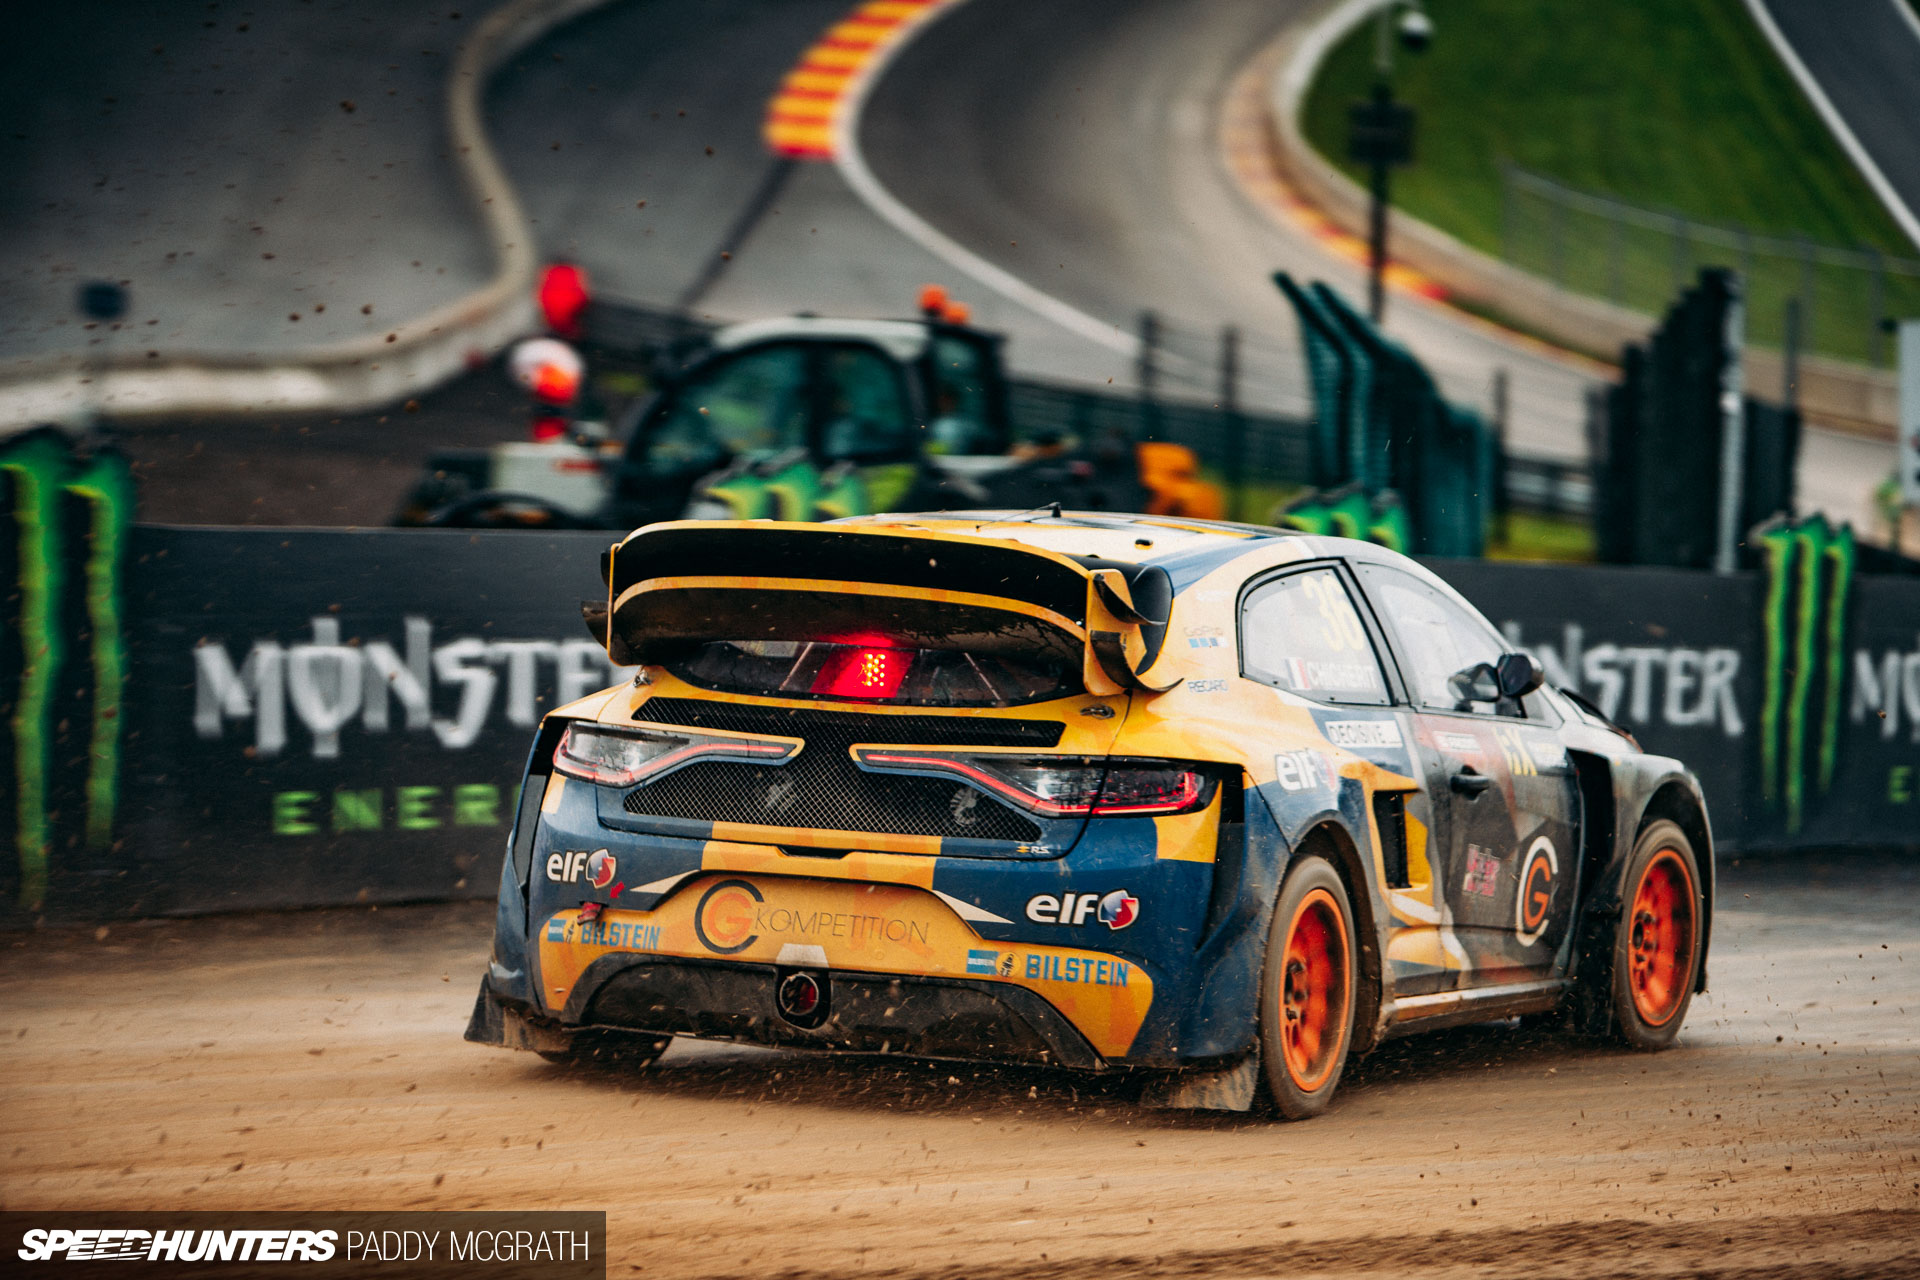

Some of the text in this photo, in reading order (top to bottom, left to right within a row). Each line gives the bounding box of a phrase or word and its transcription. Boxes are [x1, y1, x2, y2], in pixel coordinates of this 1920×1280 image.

[1187, 680, 1229, 693] RECARO
[272, 783, 523, 837] ENER
[1030, 845, 1050, 854] RS
[546, 851, 588, 883] elf
[1025, 892, 1100, 925] elf
[580, 918, 661, 951] BILSTEIN
[755, 907, 930, 945] KOMPETITION
[1025, 953, 1129, 988] BILSTEIN
